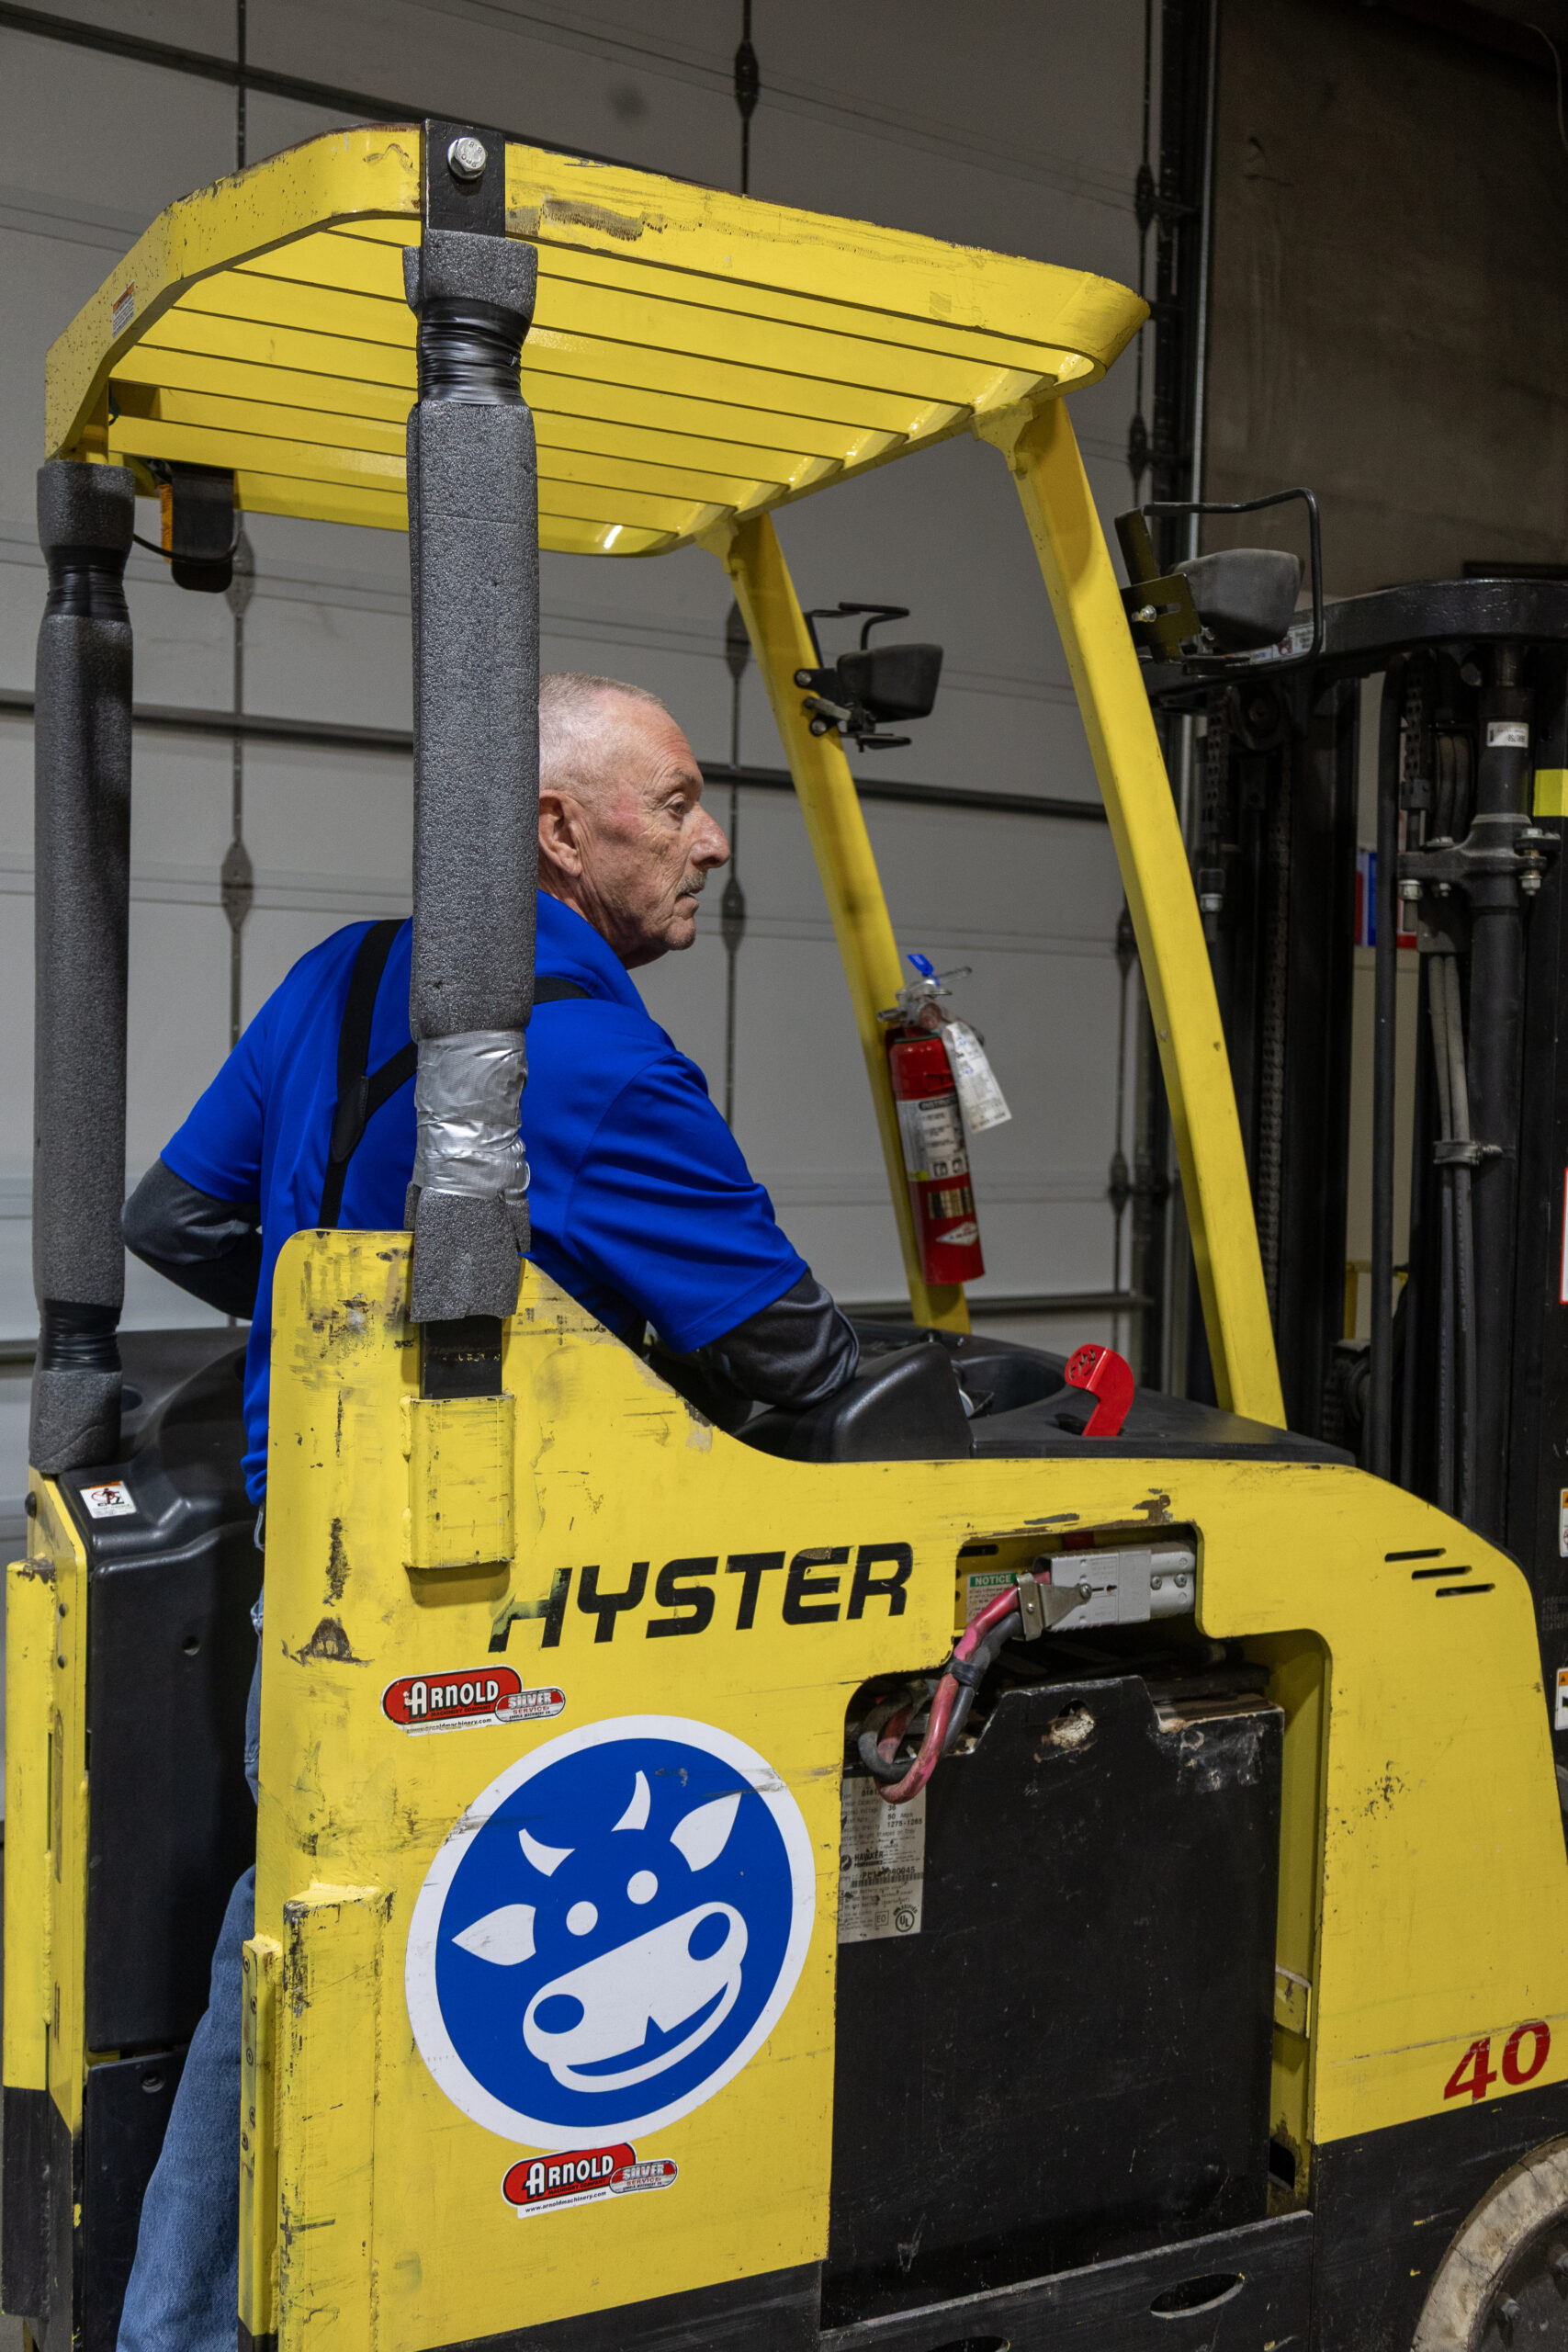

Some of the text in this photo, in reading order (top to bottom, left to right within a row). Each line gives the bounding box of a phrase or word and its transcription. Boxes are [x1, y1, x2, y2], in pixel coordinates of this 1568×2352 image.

[975, 1574, 1011, 1586] NOTICE
[488, 1542, 914, 1653] HYSTER
[508, 1691, 552, 1710] SILVER
[513, 1706, 547, 1715] SERVICE
[899, 1915, 910, 1928] UL
[1443, 2021, 1551, 2103] 40
[525, 2154, 615, 2197] ARNOLD
[622, 2163, 665, 2182] SILVER
[626, 2177, 660, 2187] SERVICE
[525, 2190, 607, 2213] www.arnoldmachinery.com
